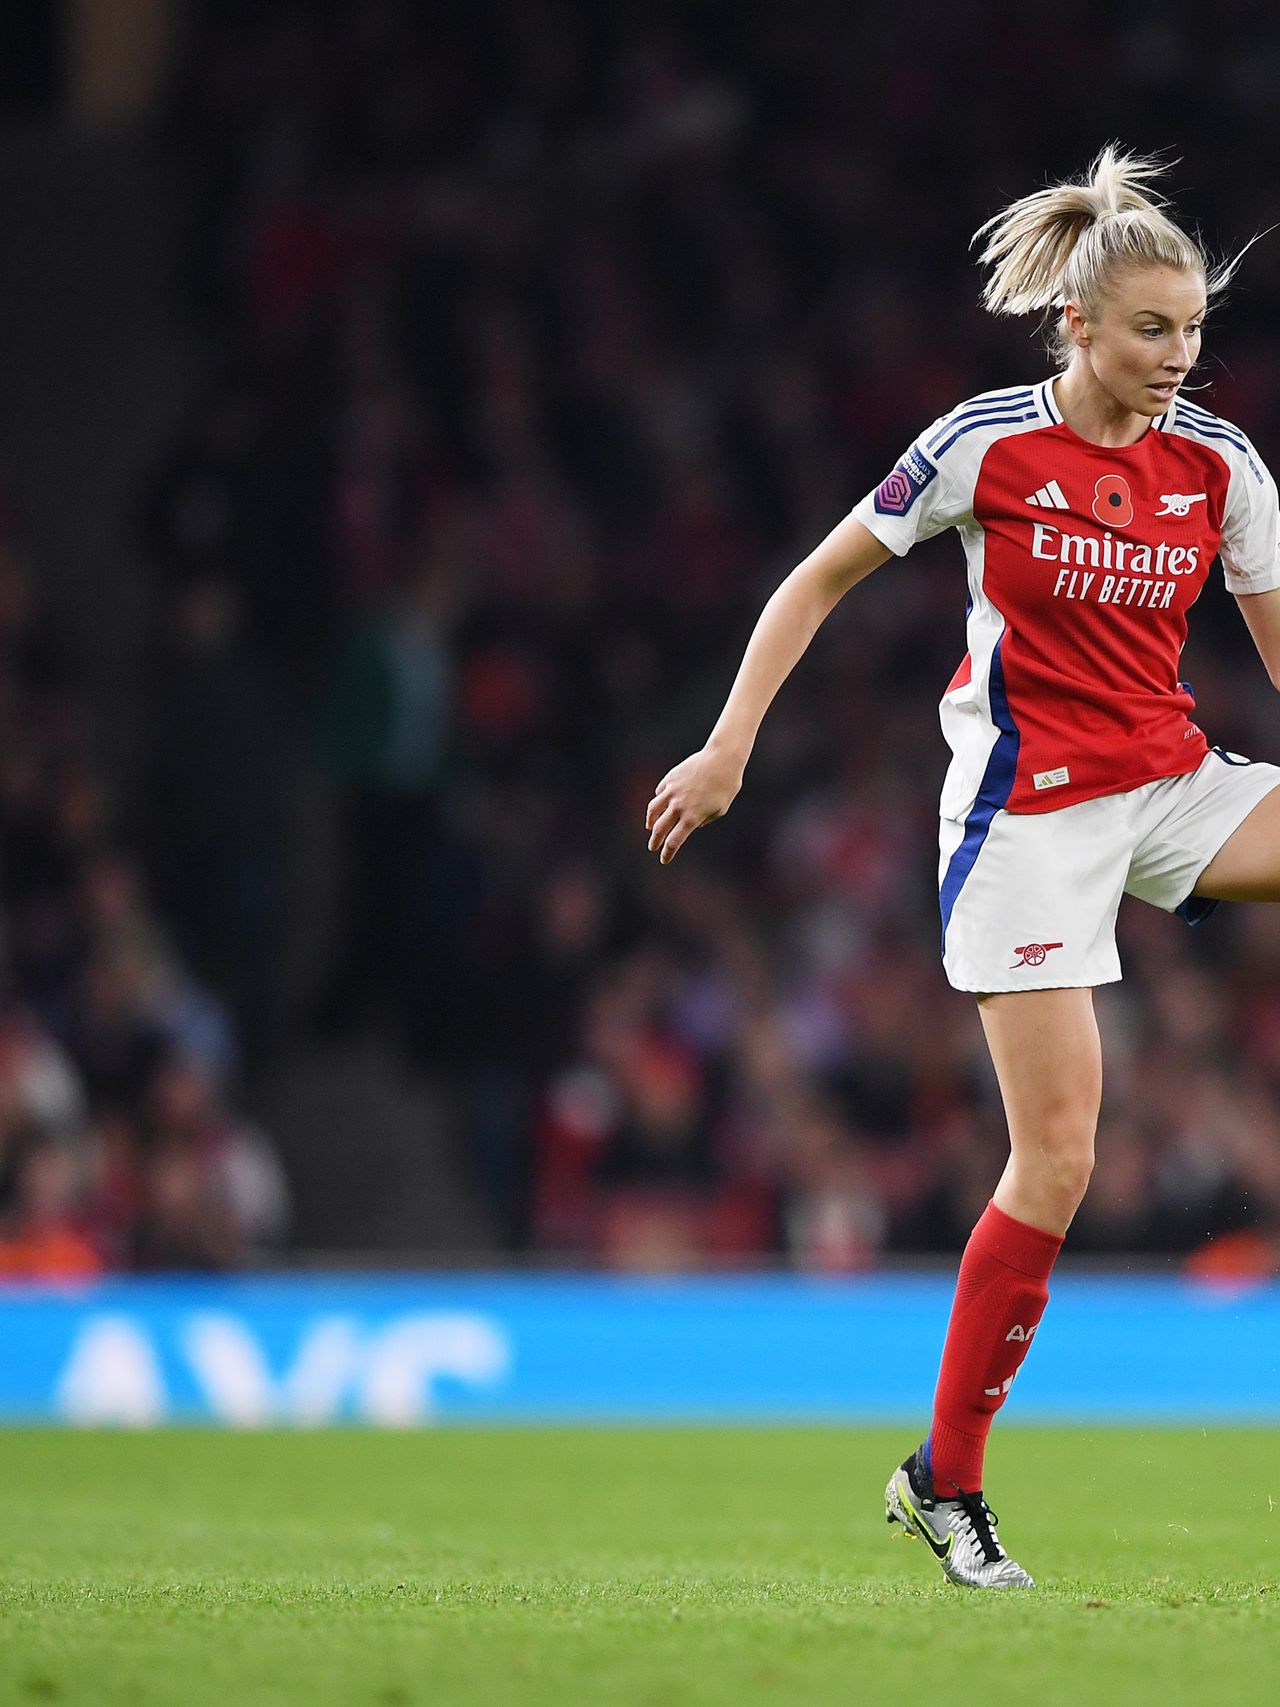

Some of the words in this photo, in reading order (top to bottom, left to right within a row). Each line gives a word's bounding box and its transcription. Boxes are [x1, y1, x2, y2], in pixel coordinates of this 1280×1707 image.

[1032, 522, 1200, 575] Emirates
[1053, 569, 1096, 600] FLY
[1098, 575, 1176, 609] BETTER
